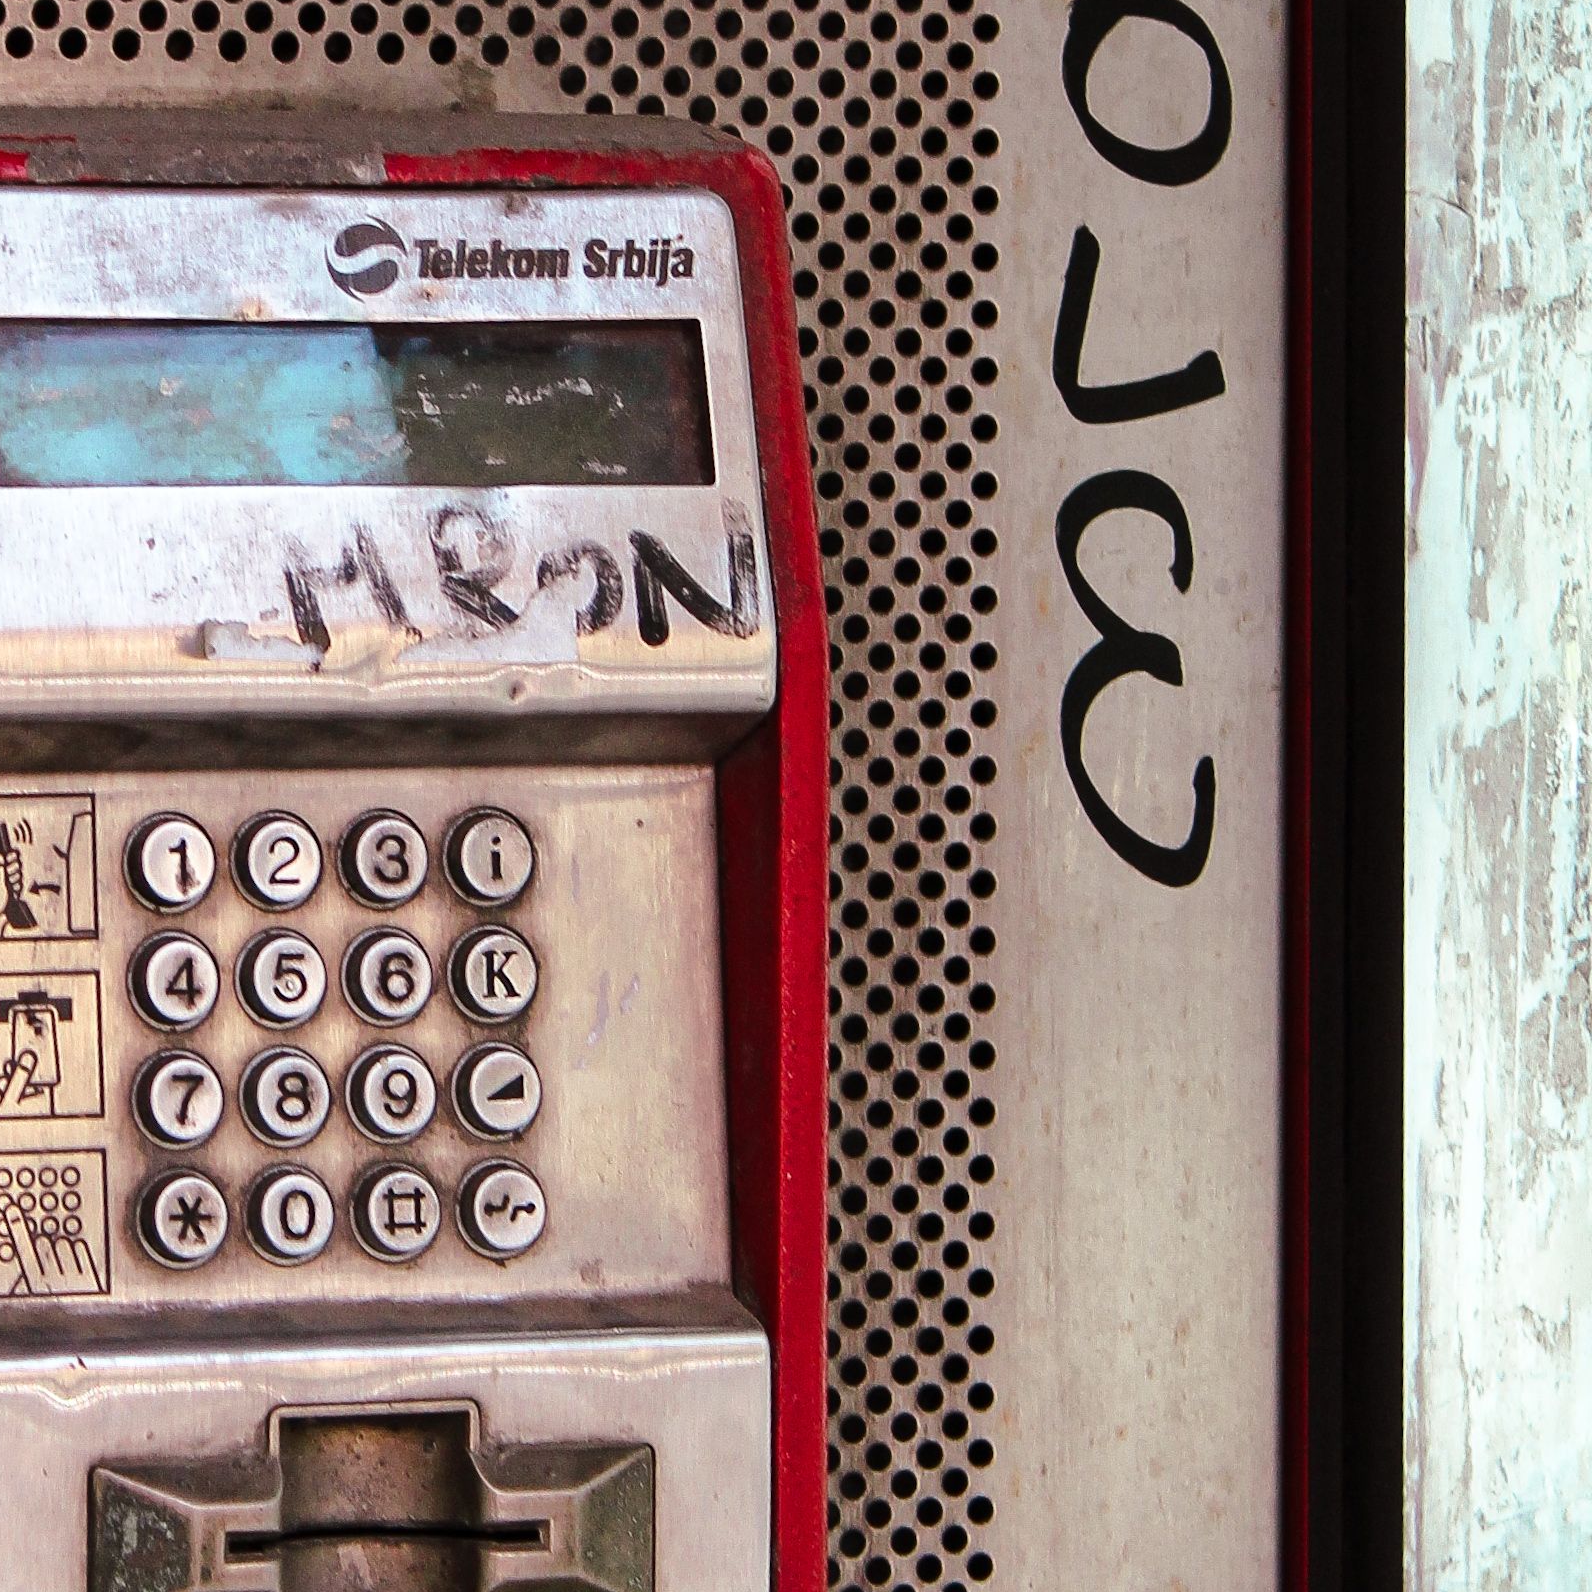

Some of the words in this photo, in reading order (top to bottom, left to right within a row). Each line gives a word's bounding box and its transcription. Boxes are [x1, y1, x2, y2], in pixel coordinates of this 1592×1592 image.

[413, 239, 570, 279] Telekom
[583, 235, 694, 286] Srbija
[168, 837, 191, 893] 1
[269, 837, 300, 884] 2
[375, 835, 408, 883] 3
[491, 837, 503, 880] i
[166, 957, 199, 1009] 4
[273, 953, 307, 1003] 5
[380, 951, 414, 1001] 6
[482, 950, 521, 999] K
[172, 1074, 204, 1124] 7
[276, 1071, 310, 1122] 8
[383, 1069, 417, 1117] 9
[280, 1189, 316, 1240] 0
